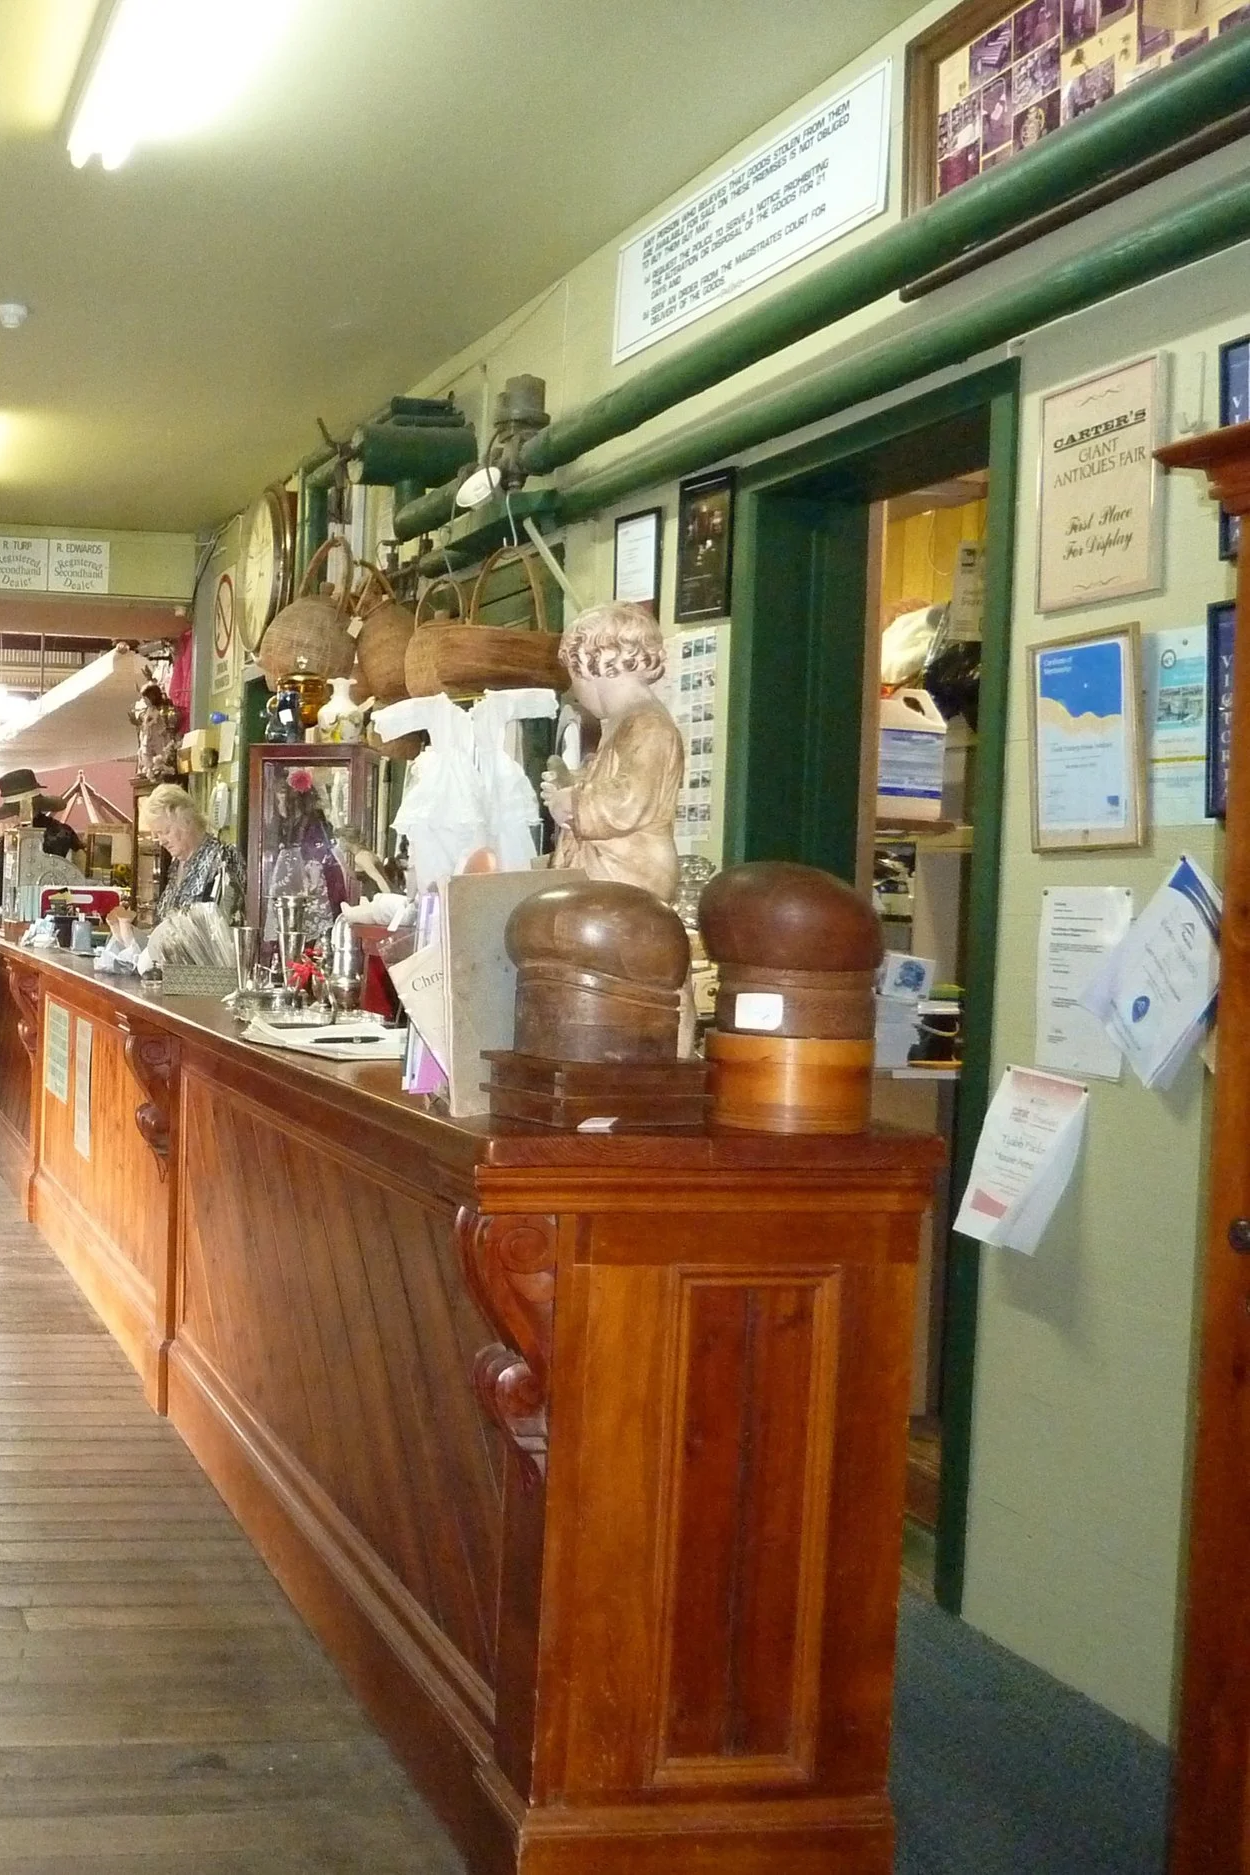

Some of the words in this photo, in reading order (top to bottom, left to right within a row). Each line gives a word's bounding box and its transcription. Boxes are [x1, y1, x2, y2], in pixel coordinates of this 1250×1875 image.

[682, 207, 696, 223] WHO
[729, 173, 745, 191] THAT
[747, 155, 771, 178] GOODS
[773, 135, 800, 160] STOLEN
[803, 117, 825, 140] FROM
[828, 100, 850, 122] THEM
[686, 215, 698, 231] FOR
[700, 203, 715, 221] SALE
[718, 195, 728, 210] ON
[730, 181, 750, 200] THESE
[752, 155, 787, 185] PREMISES
[789, 148, 796, 160] IS
[799, 136, 814, 154] NOT
[817, 113, 850, 142] OBLIGED
[679, 248, 690, 262] THE
[692, 233, 713, 254] POLICE
[725, 211, 746, 232] SERVE
[756, 189, 781, 213] NOTICE
[783, 158, 829, 194] PROHIBITING
[756, 208, 768, 224] THE
[771, 191, 796, 214] GOODS
[798, 179, 814, 197] FOR
[816, 171, 826, 186] 21
[678, 280, 698, 300] ORDER
[700, 268, 718, 287] FROM
[721, 259, 733, 274] THE
[734, 229, 782, 267] MAGISTRATES
[784, 213, 808, 236] COURT
[811, 203, 826, 220] FOR
[1053, 408, 1147, 449] CARTER'S
[1078, 437, 1120, 463] GIANT
[1053, 457, 1116, 489] ANTIQUES
[1119, 445, 1147, 467] FAIR
[1065, 512, 1095, 536] First
[1098, 504, 1133, 526] Place
[65, 543, 103, 555] EDWARDS
[1062, 541, 1083, 561] For
[1085, 528, 1134, 557] Display
[1, 574, 32, 588] Dealer
[54, 567, 103, 579] Secondhand
[57, 558, 103, 572] Registered
[63, 577, 96, 591] Dealer
